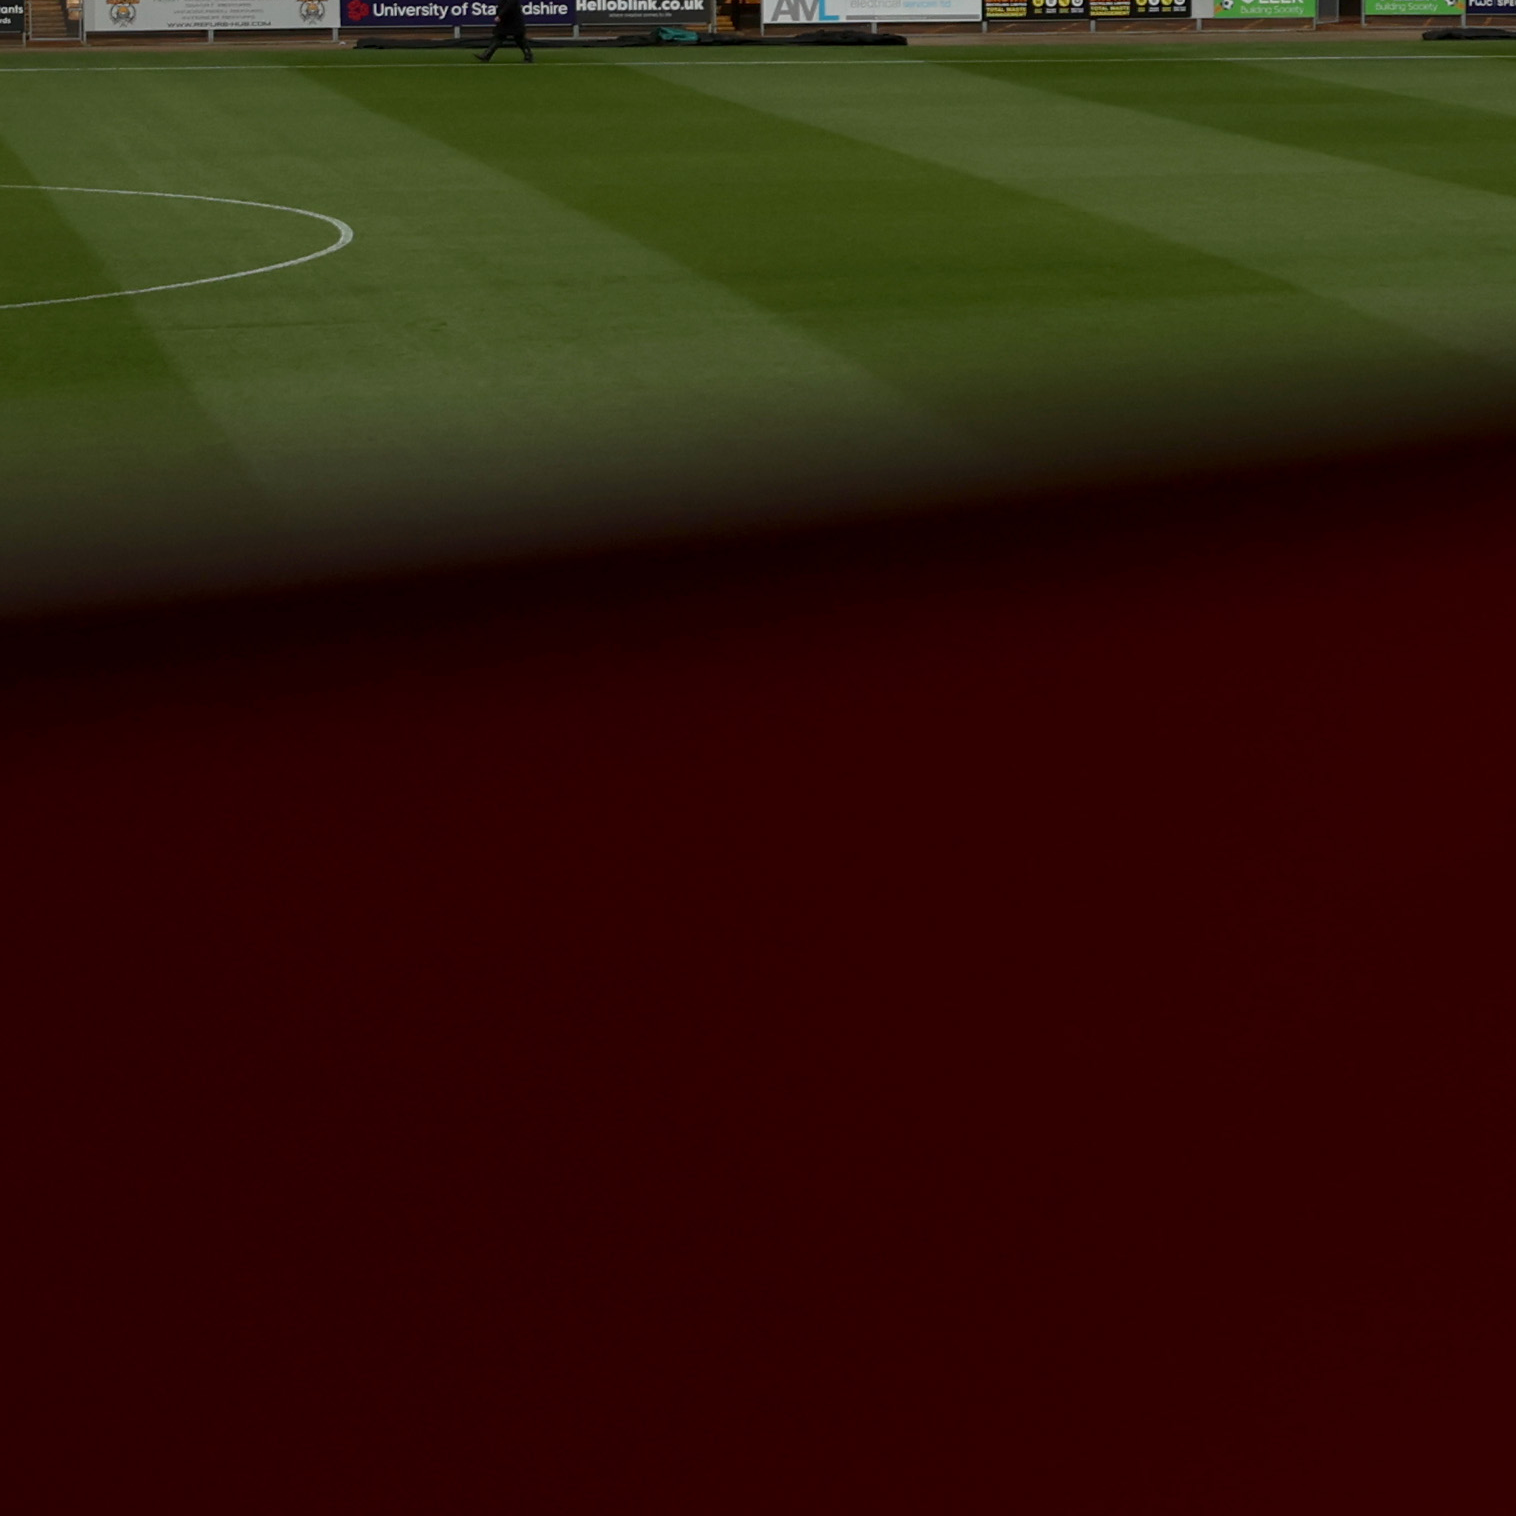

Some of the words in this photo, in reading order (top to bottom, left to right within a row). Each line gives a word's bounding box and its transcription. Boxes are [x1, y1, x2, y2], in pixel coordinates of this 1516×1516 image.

[373, 2, 449, 21] University
[451, 1, 467, 16] of
[1240, 5, 1271, 15] Building
[1274, 5, 1304, 16] Society
[1376, 2, 1406, 13] Building
[1408, 2, 1438, 14] Society
